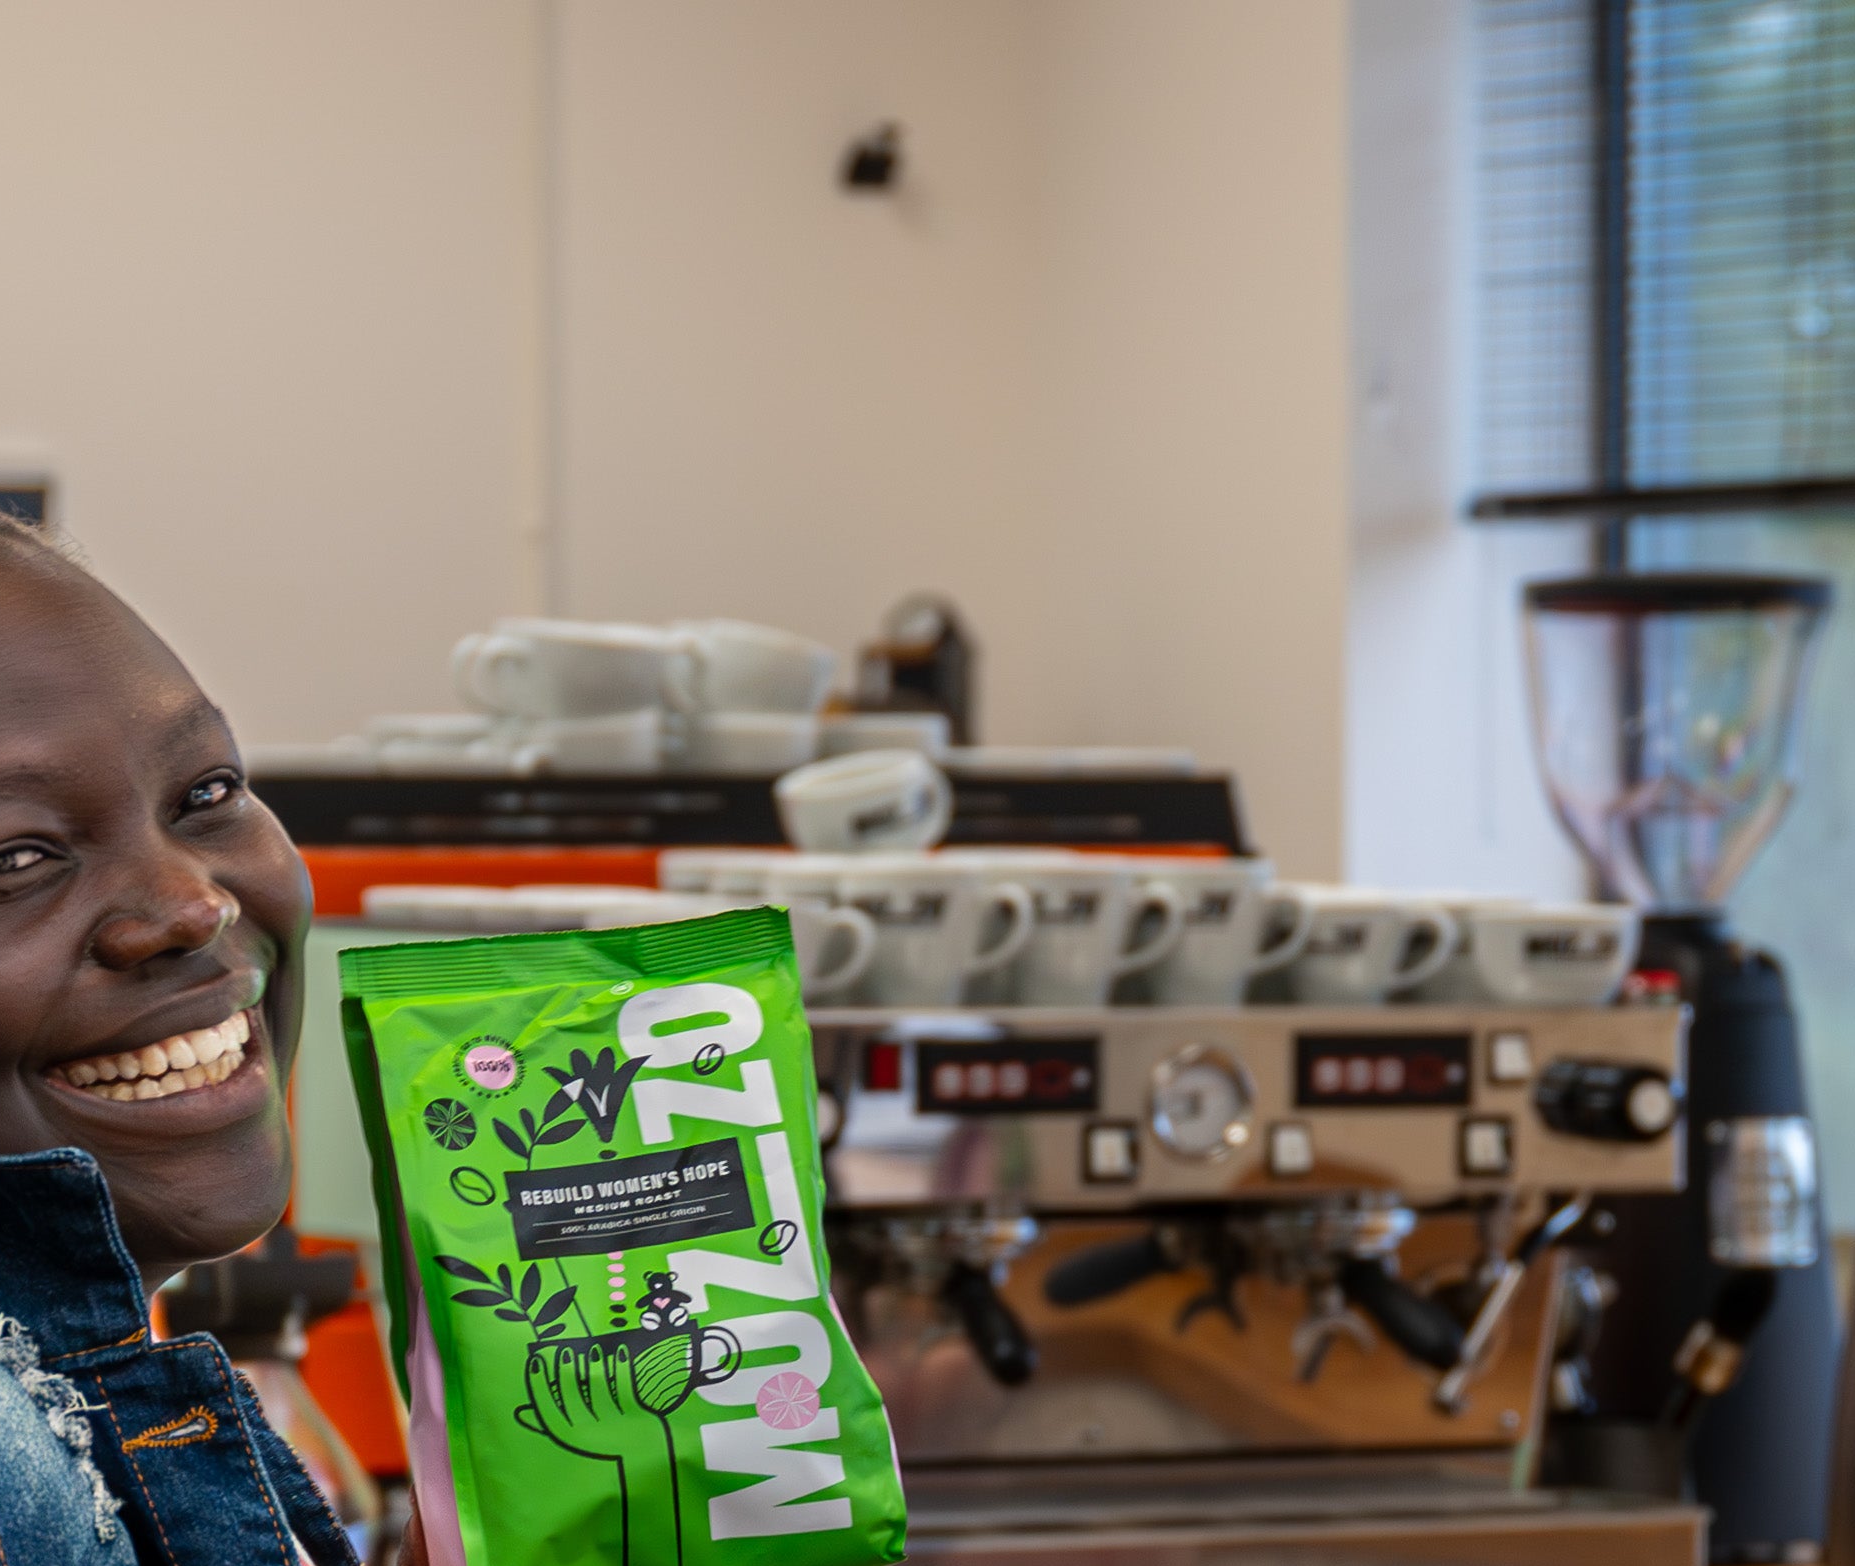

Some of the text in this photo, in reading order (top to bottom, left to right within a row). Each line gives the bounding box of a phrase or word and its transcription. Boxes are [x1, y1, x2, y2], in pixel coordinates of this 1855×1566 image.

[520, 1160, 731, 1206] REBUILD WOMEN'S HOPE
[574, 1189, 682, 1215] MEDIUM ROAST
[587, 1218, 632, 1231] ARABICA
[633, 1211, 669, 1224] SINGLE
[670, 1205, 706, 1217] ORIGIN
